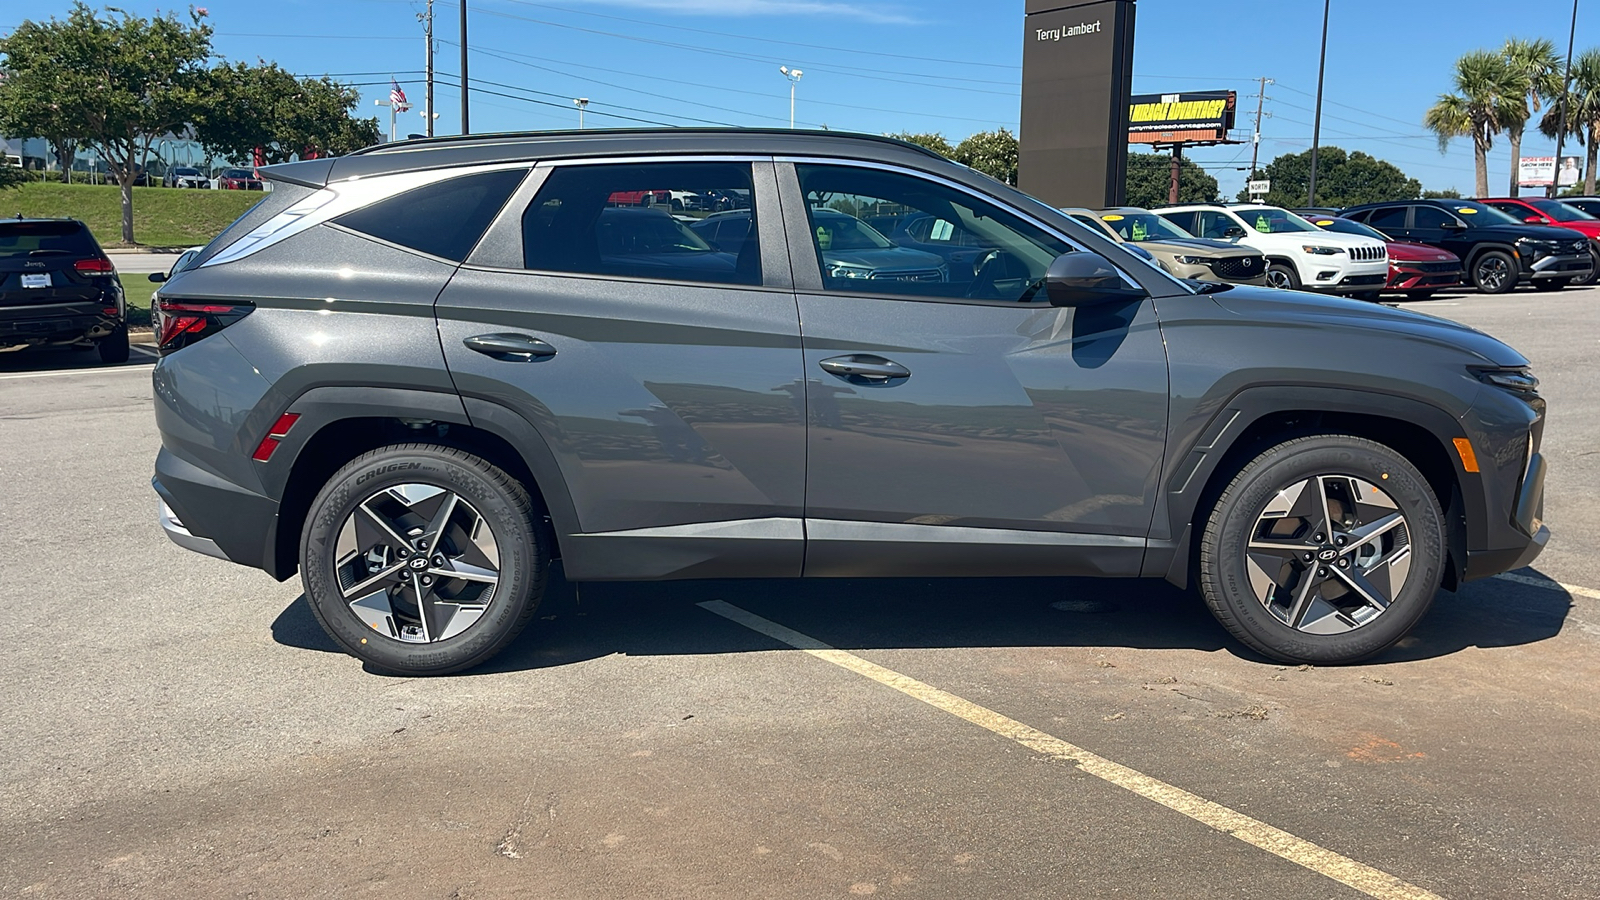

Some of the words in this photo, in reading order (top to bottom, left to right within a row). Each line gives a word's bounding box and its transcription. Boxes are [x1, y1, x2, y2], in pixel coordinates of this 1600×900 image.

[1036, 28, 1060, 41] Terry
[1062, 20, 1100, 37] Lambert
[1131, 103, 1170, 122] MIRACLE
[1167, 99, 1226, 120] ADVANTAGE?
[355, 462, 421, 485] CRUGEN
[1227, 574, 1239, 597] 103H
[496, 604, 511, 626] 103H
